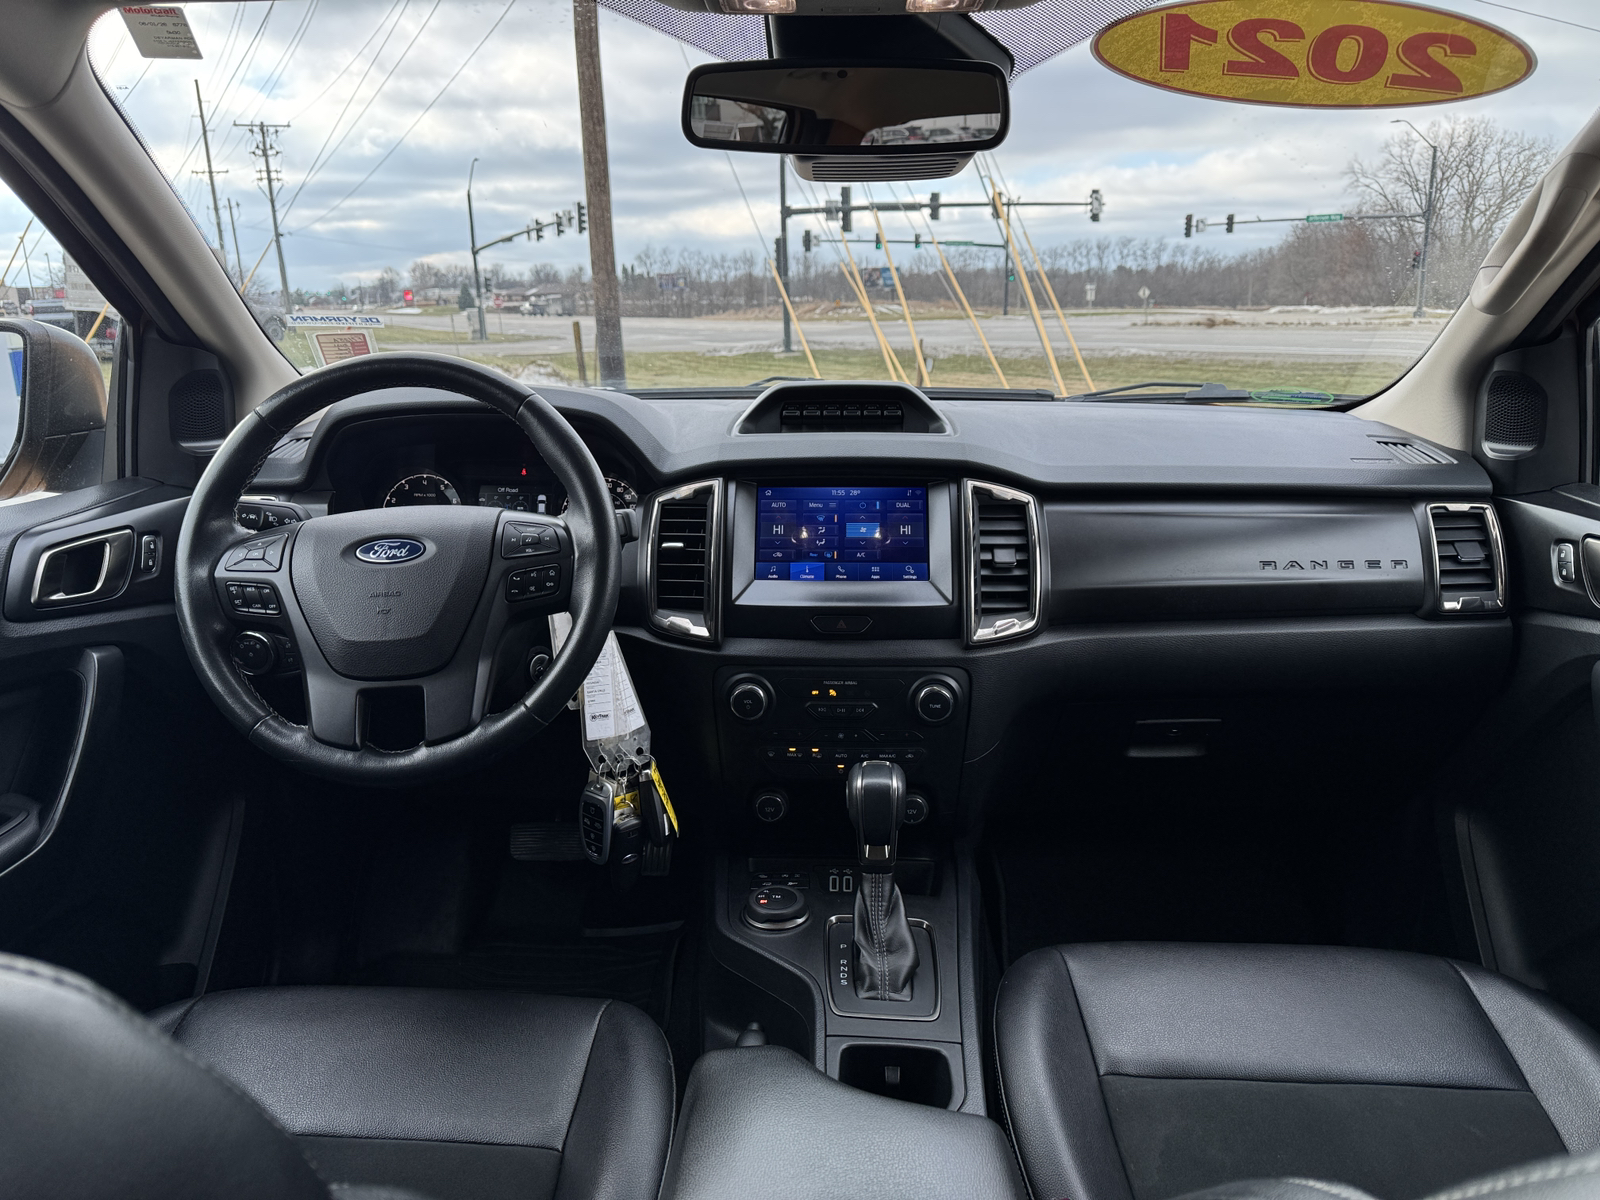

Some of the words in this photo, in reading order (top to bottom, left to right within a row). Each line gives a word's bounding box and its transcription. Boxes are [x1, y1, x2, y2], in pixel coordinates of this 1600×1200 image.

[772, 524, 784, 535] HI
[900, 524, 912, 535] HI
[369, 542, 410, 558] Ford
[1259, 560, 1409, 570] RANGER
